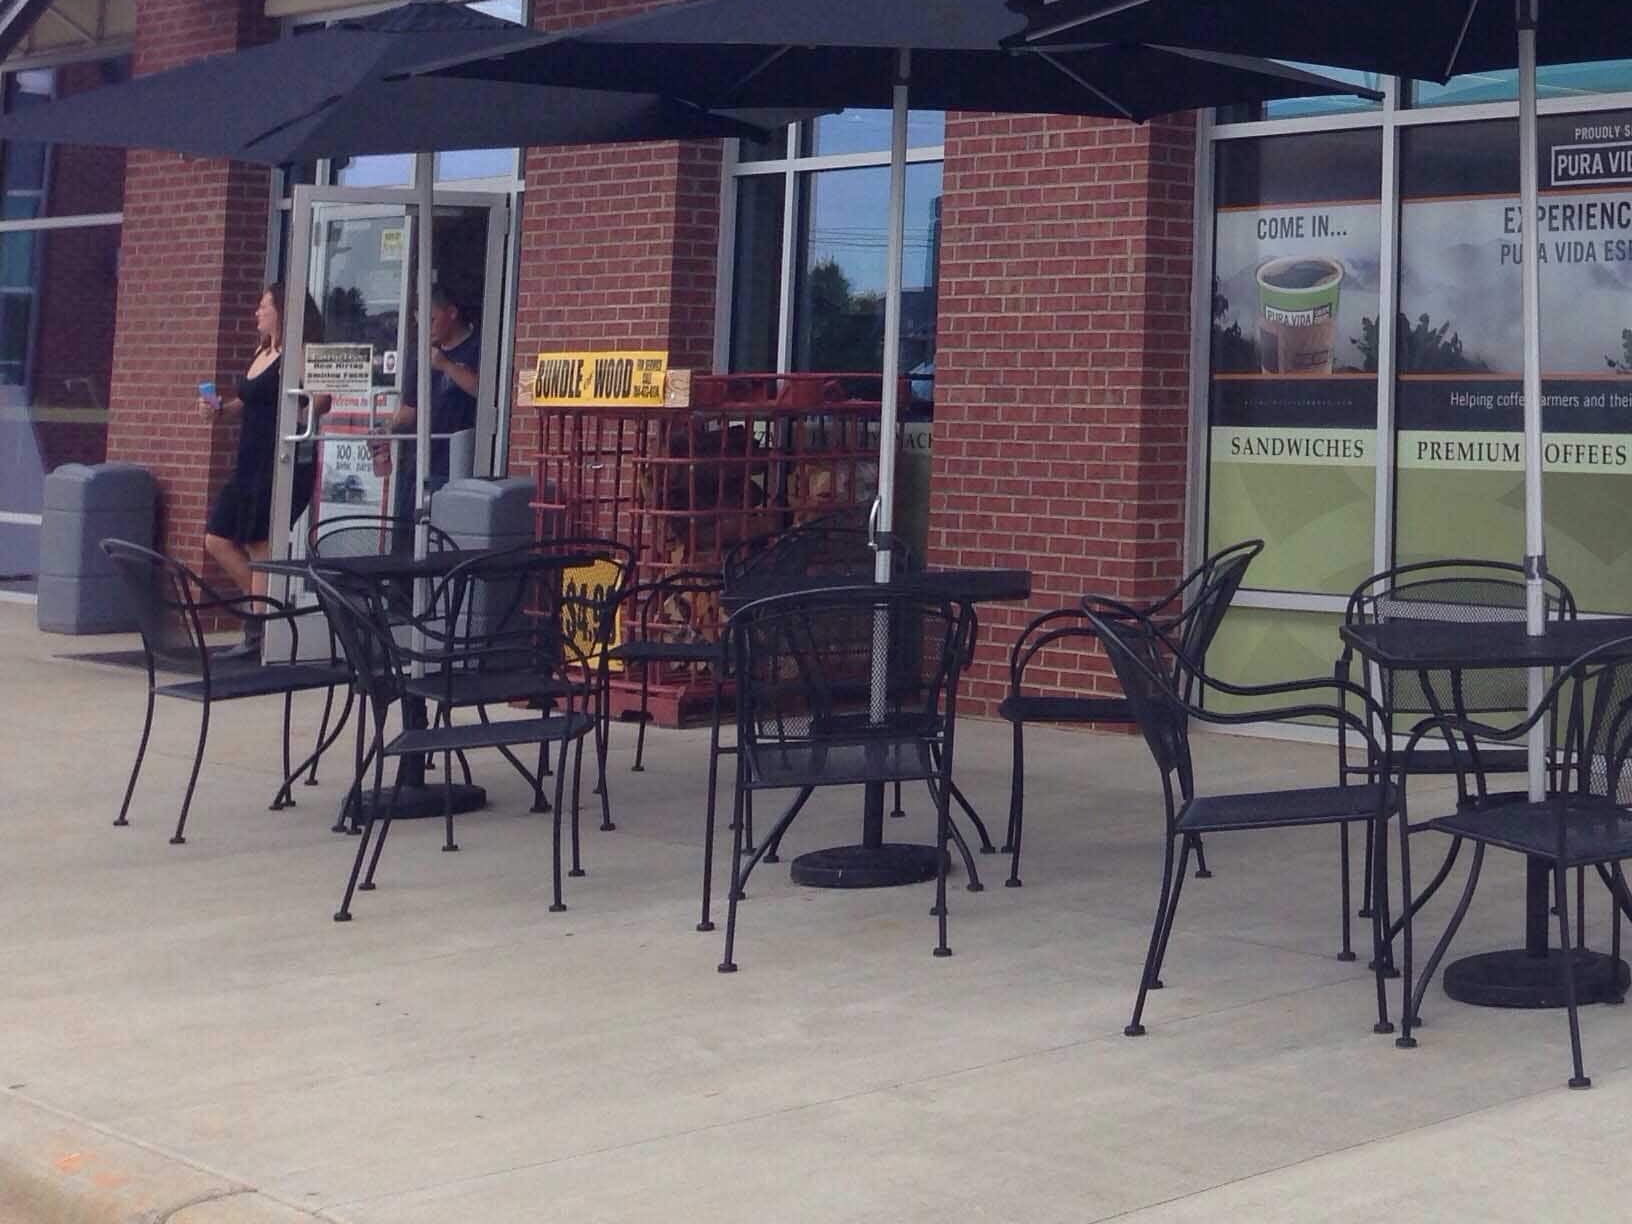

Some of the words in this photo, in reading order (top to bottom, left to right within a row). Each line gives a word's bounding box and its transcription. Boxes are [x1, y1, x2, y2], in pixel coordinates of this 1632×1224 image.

[1575, 125, 1621, 140] PROUDLY
[1557, 153, 1604, 176] PURA
[1257, 216, 1304, 240] COME
[1311, 215, 1347, 238] IN...
[1500, 242, 1548, 265] PUA
[1555, 240, 1597, 264] VIDA
[535, 359, 584, 398] BUNDLE
[593, 358, 633, 398] WOOD
[1450, 392, 1493, 409] Helping
[1496, 393, 1525, 407] coffe
[1539, 393, 1579, 408] armers
[1583, 392, 1605, 408] and
[1231, 436, 1364, 458] SANDWICHES
[1416, 440, 1521, 463] PREMIUM
[1544, 443, 1627, 466] OFFEES
